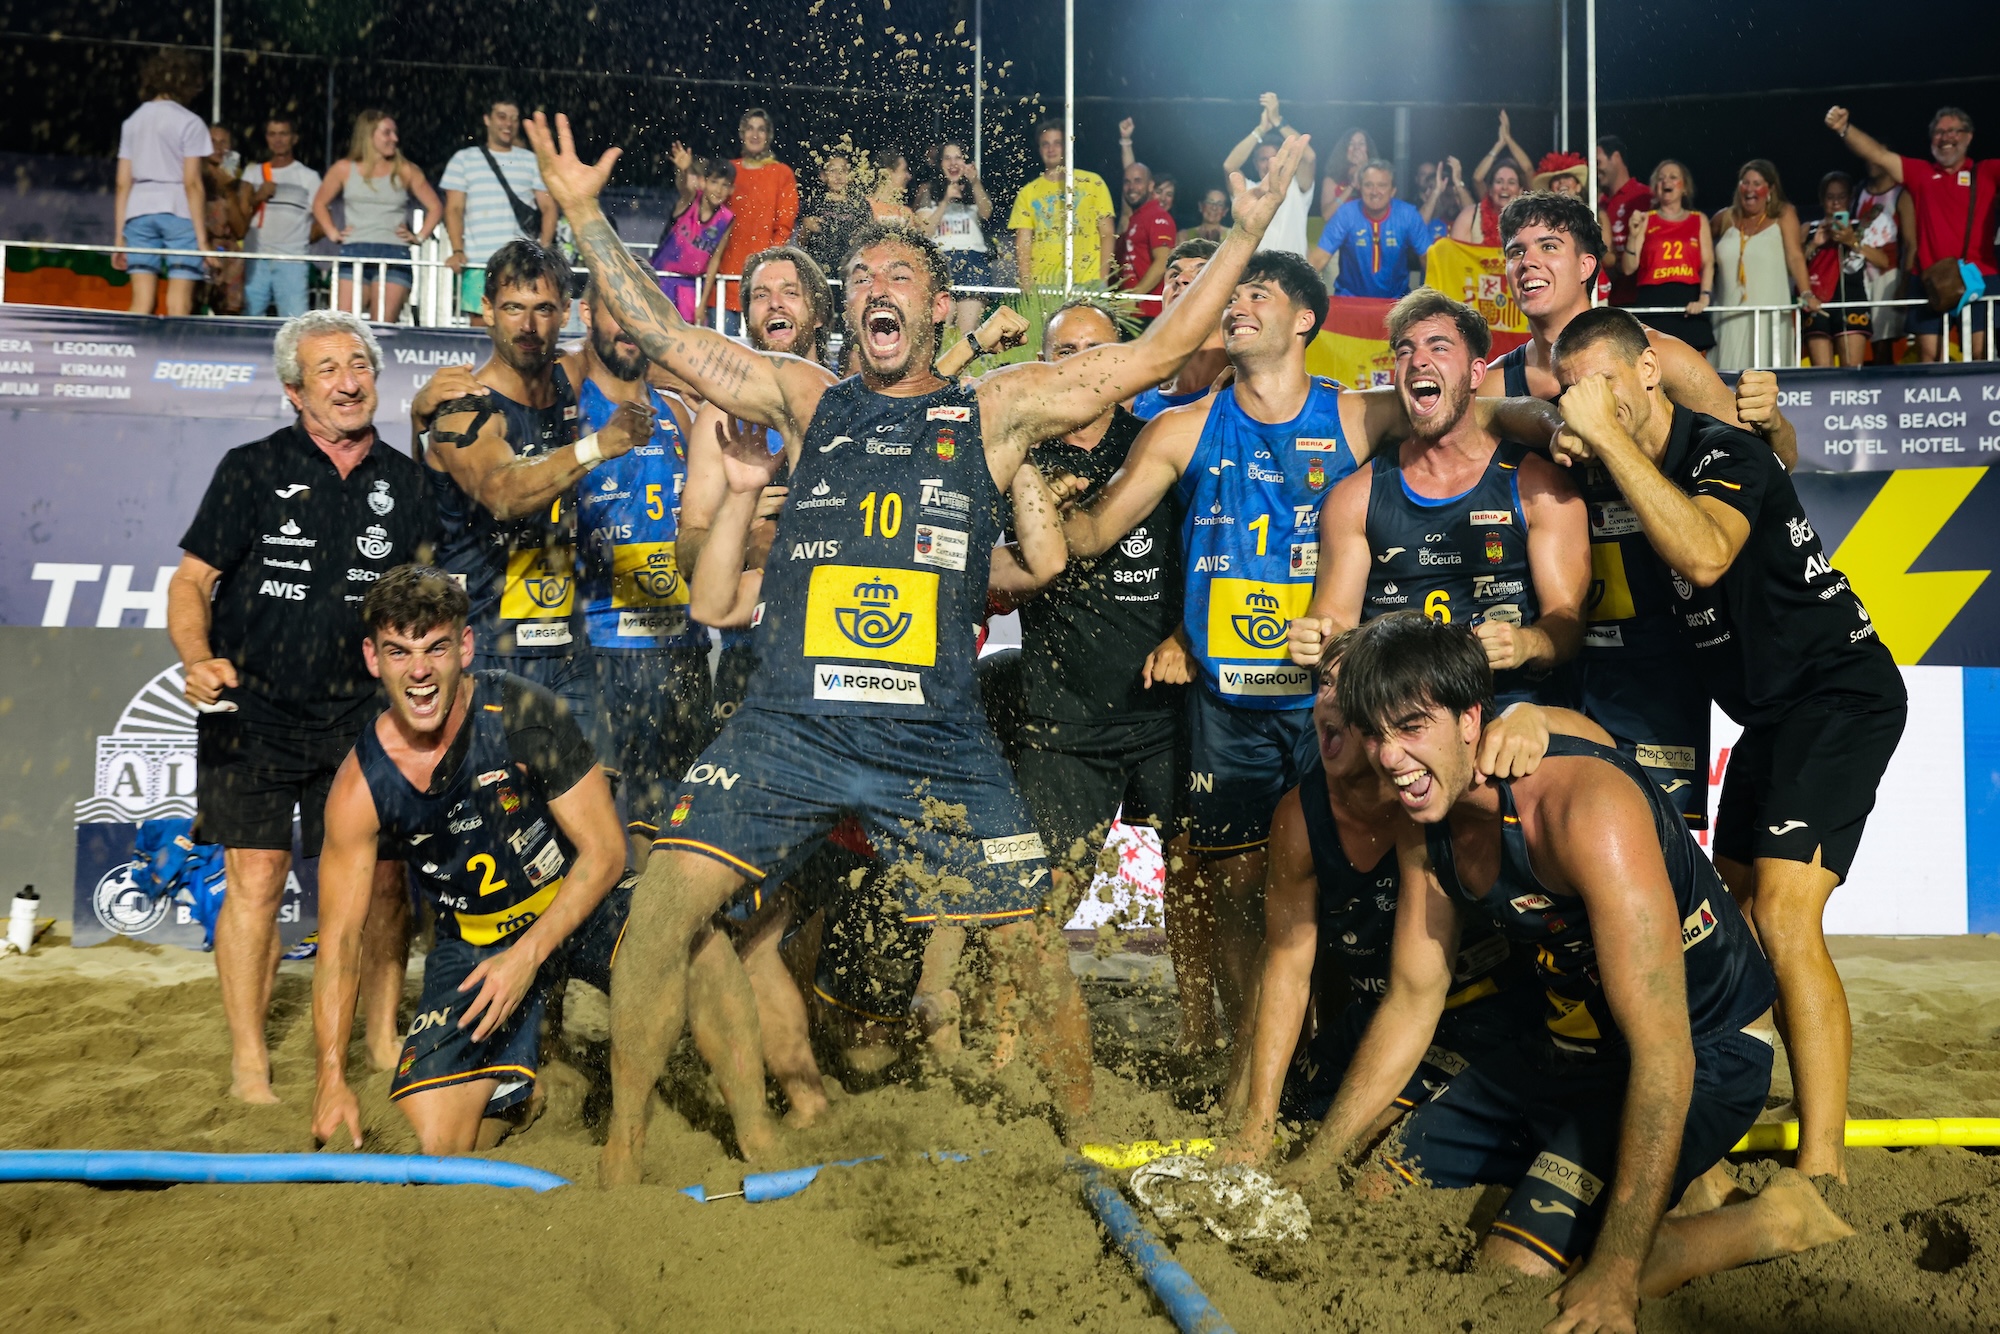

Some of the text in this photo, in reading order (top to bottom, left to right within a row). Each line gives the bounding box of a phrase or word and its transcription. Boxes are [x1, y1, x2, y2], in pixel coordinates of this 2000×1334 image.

[1662, 240, 1683, 260] 22
[1653, 263, 1694, 279] ESPAÑA
[53, 341, 136, 358] LEODIKYA
[394, 349, 476, 366] YALIHAN
[60, 362, 126, 378] KIRMAN
[154, 361, 254, 383] BOARDEE
[53, 383, 131, 399] PREMIUM
[1776, 391, 1812, 406] ORE
[1830, 389, 1882, 406] FIRST
[1904, 386, 1962, 404] KAILA
[1824, 414, 1888, 431] CLASS
[1899, 411, 1967, 429] BEACH
[877, 444, 912, 456] Ceuta
[1825, 439, 1888, 455] HOTEL
[1902, 437, 1966, 454] HOTEL
[1257, 471, 1285, 484] Ceuta
[645, 483, 664, 521] 5
[795, 496, 848, 511] Santander
[859, 491, 903, 539] 10
[592, 523, 632, 541] AVIS
[1248, 513, 1270, 557] 1
[262, 534, 318, 548] Santander
[790, 539, 839, 562] AVIS
[1193, 554, 1231, 573] AVIS
[1429, 554, 1462, 566] Ceuta
[1113, 567, 1160, 584] sacyr
[31, 563, 178, 628] TH
[258, 579, 307, 601] AVIS
[1424, 589, 1452, 625] 6
[820, 673, 917, 691] VARGROUP
[1224, 671, 1308, 687] VARGROUP
[466, 852, 509, 898] 2
